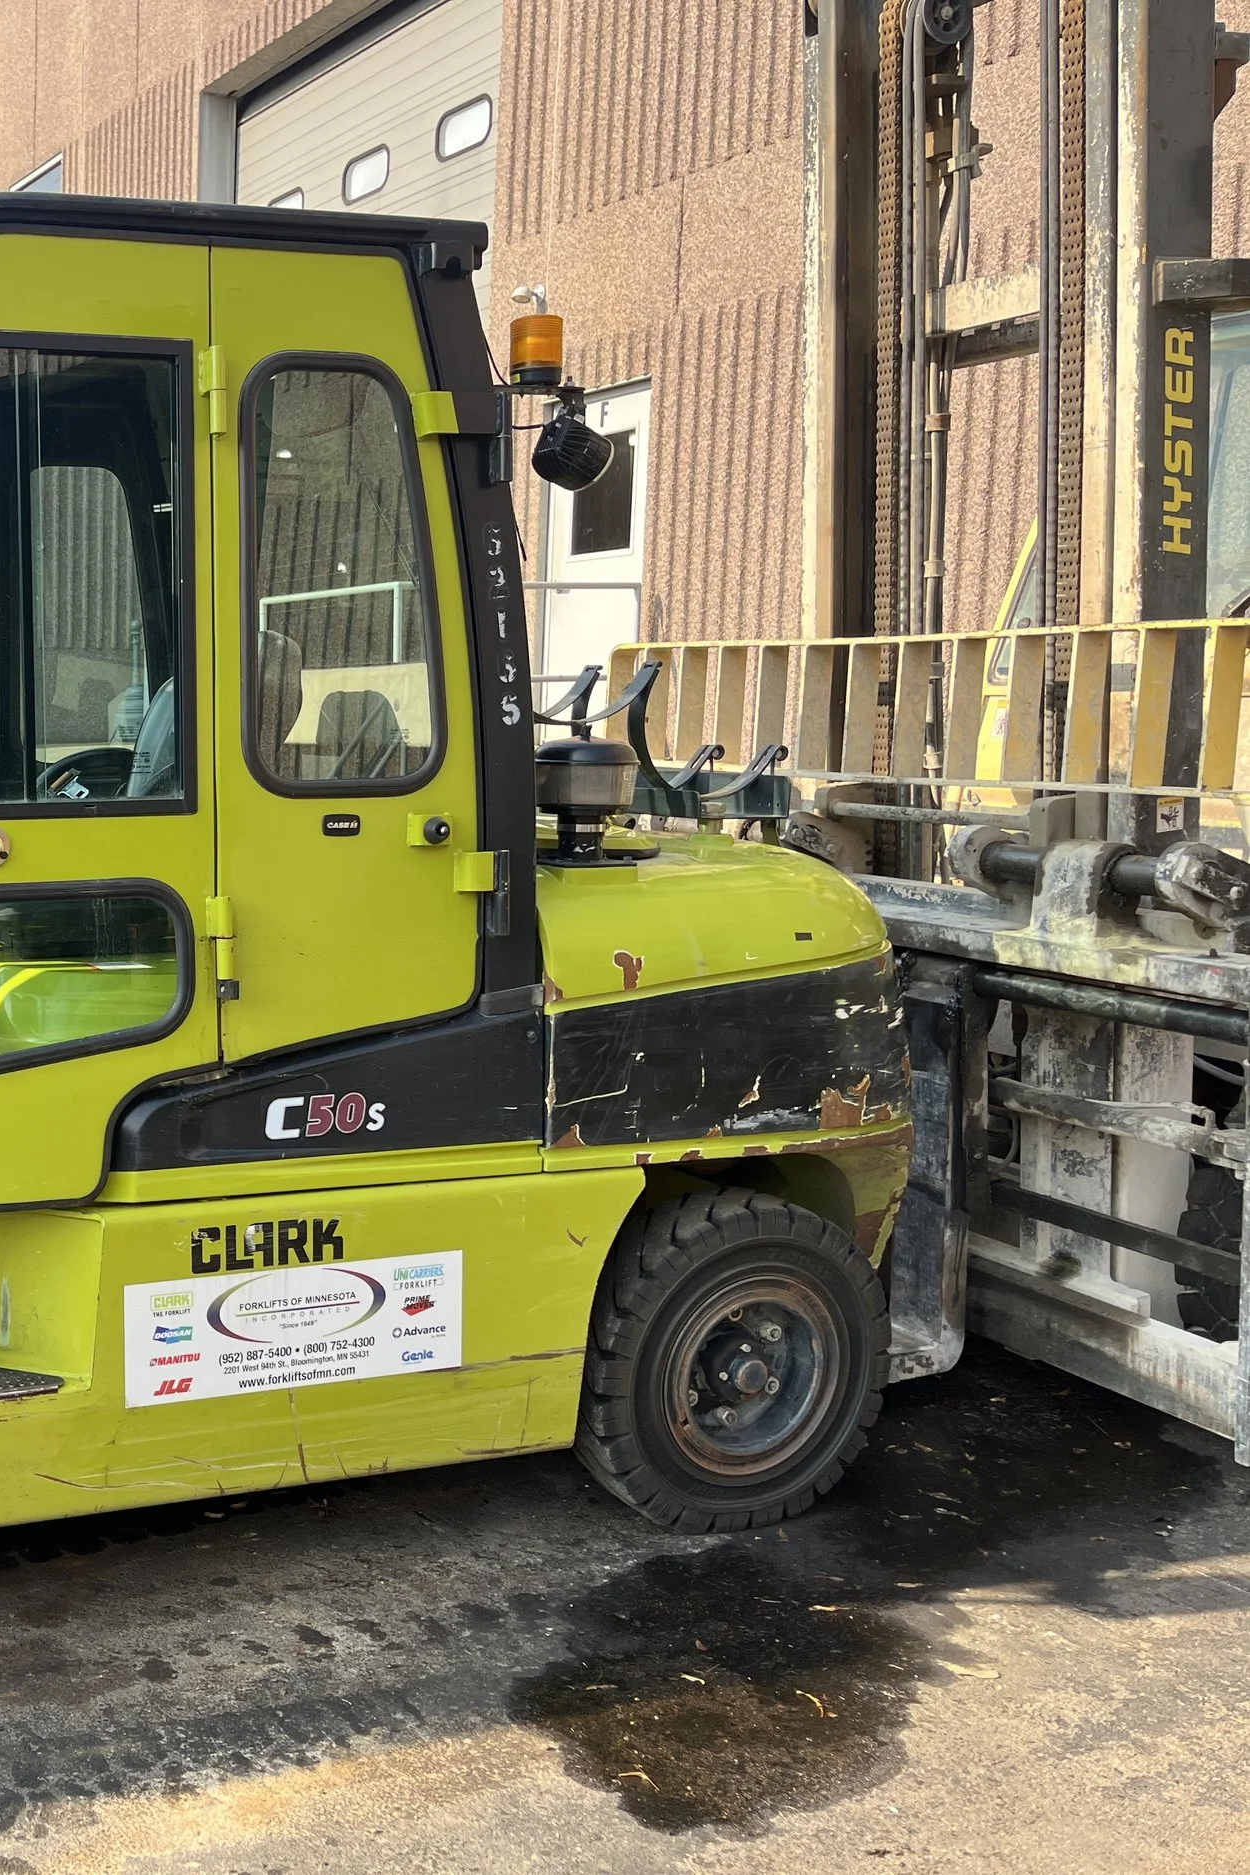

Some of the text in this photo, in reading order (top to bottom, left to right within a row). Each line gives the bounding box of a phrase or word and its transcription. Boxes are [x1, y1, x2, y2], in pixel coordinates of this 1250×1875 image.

[1163, 327, 1195, 555] HYSTER
[326, 821, 350, 829] CASE
[191, 1216, 344, 1275] CLARK
[400, 1278, 437, 1290] FORKLIFT
[153, 1293, 191, 1309] CLARK
[239, 1291, 356, 1312] FORKLIFTS OF MINNESOTA
[404, 1294, 431, 1304] PRIME
[405, 1300, 435, 1310] MOVER
[153, 1308, 190, 1318] THE FORKLIFT
[245, 1306, 350, 1323] INCORPORATED
[154, 1328, 192, 1340] DOOSAN
[403, 1324, 446, 1337] Advance
[219, 1336, 375, 1366] (952) 887-5400 (800) 752-4300
[402, 1349, 434, 1362] Genie
[157, 1353, 200, 1366] MANITOU
[224, 1365, 240, 1374] 2201
[242, 1363, 259, 1373] West
[261, 1361, 276, 1370] 94th
[291, 1355, 335, 1367] Bloomington,
[337, 1352, 348, 1361] MN
[350, 1350, 369, 1359] 55431
[239, 1366, 356, 1389] www.forkliftsofmn.com
[153, 1378, 193, 1396] JLG
